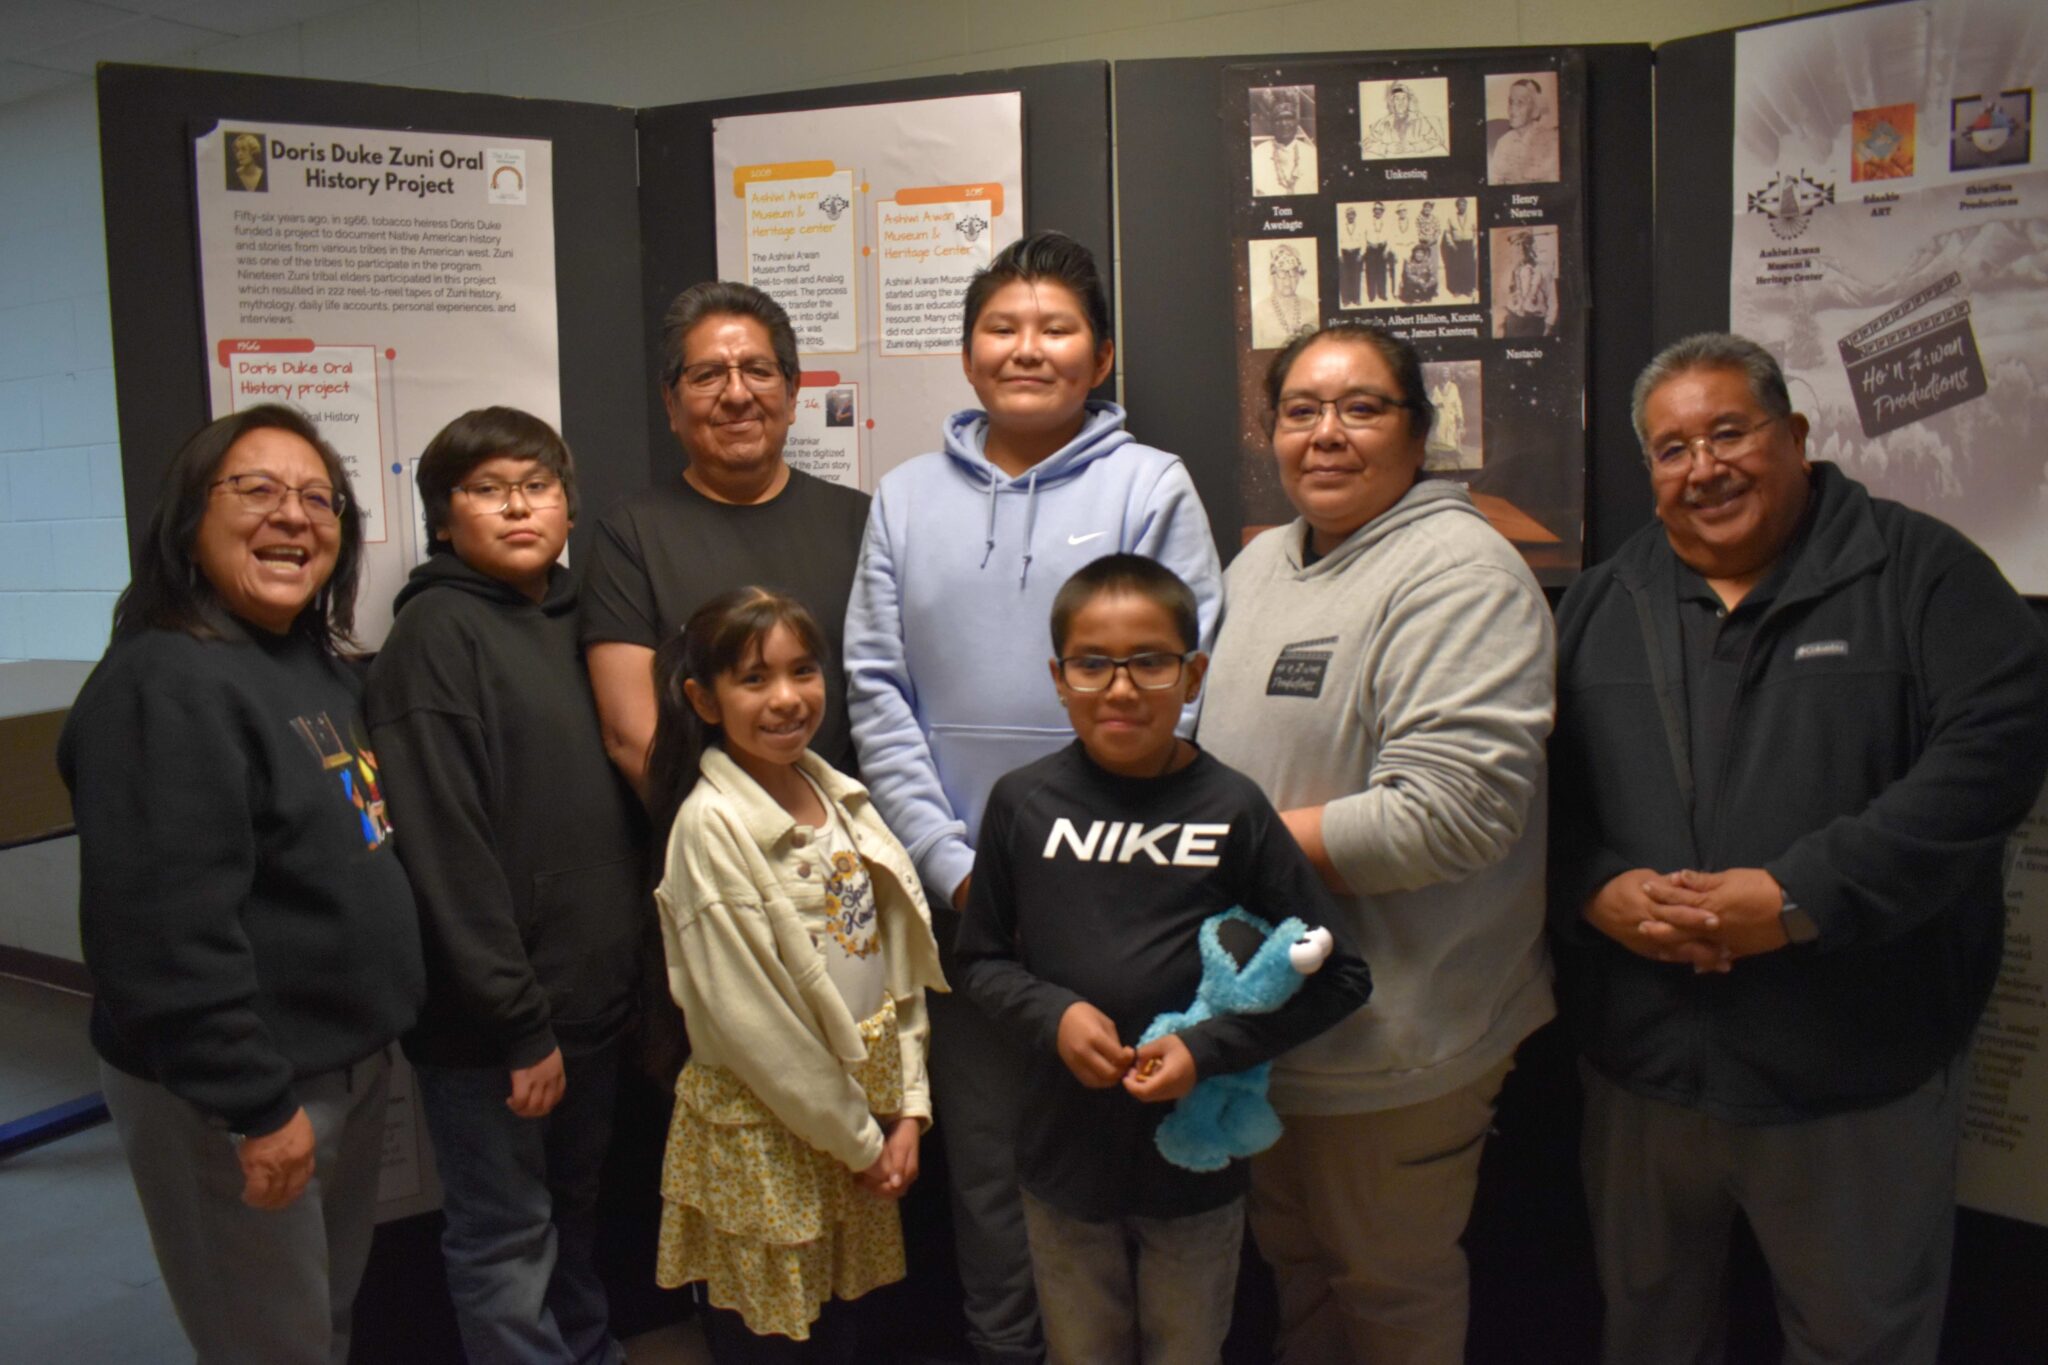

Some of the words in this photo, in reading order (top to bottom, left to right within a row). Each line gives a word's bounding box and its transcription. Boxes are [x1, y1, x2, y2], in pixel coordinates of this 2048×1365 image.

[271, 140, 325, 162] Doris
[332, 143, 382, 164] Duke
[389, 146, 434, 167] Zuni
[440, 149, 484, 170] Oral
[306, 168, 379, 195] History
[385, 172, 454, 198] Project
[1512, 194, 1539, 205] Henry
[752, 210, 793, 219] Museum
[1272, 206, 1293, 217] Tom
[1871, 207, 1892, 216] ART
[234, 210, 274, 223] Fifty-six
[278, 213, 305, 224] years
[332, 214, 341, 223] in
[372, 217, 411, 227] tobacco
[414, 217, 448, 228] heiress
[450, 219, 474, 229] Doris
[477, 219, 501, 230] Duke
[235, 225, 272, 236] funded
[275, 229, 281, 237] a
[284, 227, 319, 239] project
[322, 229, 332, 238] to
[335, 228, 386, 239] document
[389, 231, 419, 241] Native
[422, 232, 468, 242] American
[470, 233, 501, 245] history
[752, 225, 795, 241] Heritage
[885, 231, 928, 241] Museum
[236, 241, 255, 250] and
[258, 241, 292, 251] stories
[295, 242, 319, 252] from
[321, 244, 357, 253] various
[360, 243, 387, 254] tribes
[390, 246, 398, 254] in
[401, 246, 416, 255] the
[419, 246, 464, 256] American
[493, 248, 513, 258] Zuni
[885, 247, 929, 263] Heritage
[753, 253, 767, 261] The
[260, 258, 279, 266] one
[283, 256, 292, 266] of
[295, 257, 311, 266] the
[314, 258, 342, 267] tribes
[345, 258, 355, 267] to
[357, 258, 409, 270] participate
[412, 260, 420, 269] in
[422, 260, 437, 269] the
[753, 265, 785, 273] Museum
[787, 264, 810, 272] found
[1768, 262, 1802, 270] Museum
[237, 269, 285, 280] Nineteen
[288, 270, 309, 280] Zuni
[312, 271, 337, 281] tribal
[340, 272, 371, 282] elders
[374, 273, 431, 285] participated
[433, 275, 442, 283] in
[445, 275, 461, 284] this
[464, 275, 496, 286] project
[800, 275, 815, 283] and
[816, 274, 844, 284] Analog
[1756, 275, 1792, 284] Heritage
[1794, 274, 1823, 282] Center
[239, 284, 269, 295] which
[272, 285, 313, 295] resulted
[316, 286, 326, 295] in
[328, 288, 345, 296] 222
[347, 286, 403, 297] reel-to-reel
[405, 288, 432, 298] tapes
[435, 288, 443, 297] of
[446, 288, 466, 298] Zuni
[801, 288, 815, 296] The
[817, 287, 847, 297] process
[886, 290, 913, 299] started
[915, 290, 936, 299] using
[939, 288, 952, 296] the
[299, 300, 323, 312] daily
[325, 301, 340, 310] life
[392, 302, 434, 313] personal
[497, 304, 516, 312] and
[789, 300, 817, 309] transfer
[820, 300, 832, 308] the
[886, 302, 901, 310] files
[816, 311, 839, 322] digital
[924, 314, 945, 323] Many
[1388, 315, 1414, 325] Albert
[886, 328, 899, 336] did
[901, 327, 914, 335] not
[916, 326, 961, 334] understand
[1411, 328, 1437, 338] James
[886, 341, 903, 349] Zuni
[905, 340, 922, 349] only
[924, 339, 954, 348] spoken
[239, 361, 276, 374] Doris
[282, 361, 318, 374] Duke
[323, 361, 353, 374] Oral
[240, 381, 292, 400] History
[298, 381, 350, 399] project
[1873, 368, 1968, 422] Productions
[325, 411, 359, 424] History
[790, 437, 820, 446] Shankar
[799, 449, 811, 457] the
[813, 448, 845, 459] digitized
[799, 461, 811, 469] the
[813, 461, 829, 470] Zuni
[832, 461, 850, 471] story
[1042, 817, 1230, 866] NIKE
